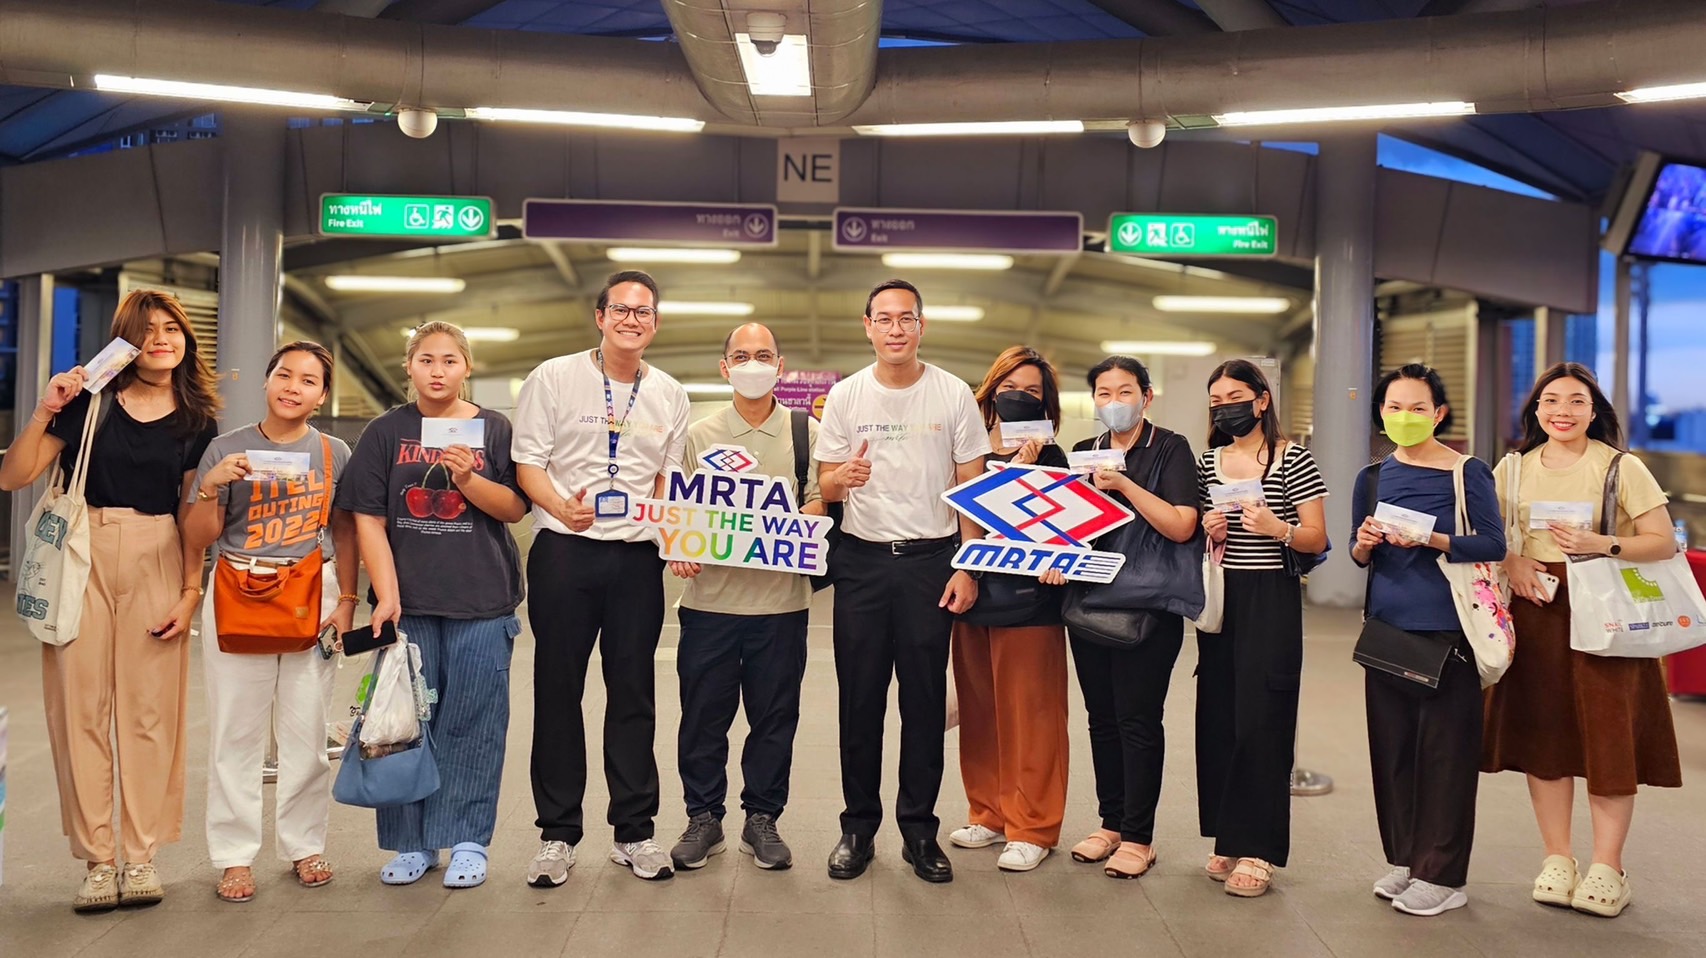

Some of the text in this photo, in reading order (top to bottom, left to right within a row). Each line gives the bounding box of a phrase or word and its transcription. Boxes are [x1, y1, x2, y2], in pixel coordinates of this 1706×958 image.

[784, 153, 832, 182] NE
[328, 219, 364, 228] Fire Exit
[1232, 239, 1268, 249] Fire Exit
[579, 415, 598, 424] JUST
[857, 424, 873, 433] JUST
[891, 424, 908, 432] WAY
[669, 471, 792, 513] MRTA
[248, 493, 324, 521] OUTING
[633, 503, 697, 526] JUST
[704, 509, 754, 532] THE
[762, 515, 819, 539] WAY
[243, 509, 320, 550] 2022
[658, 527, 819, 570] YOU ARE
[956, 543, 1080, 575] MRTA
